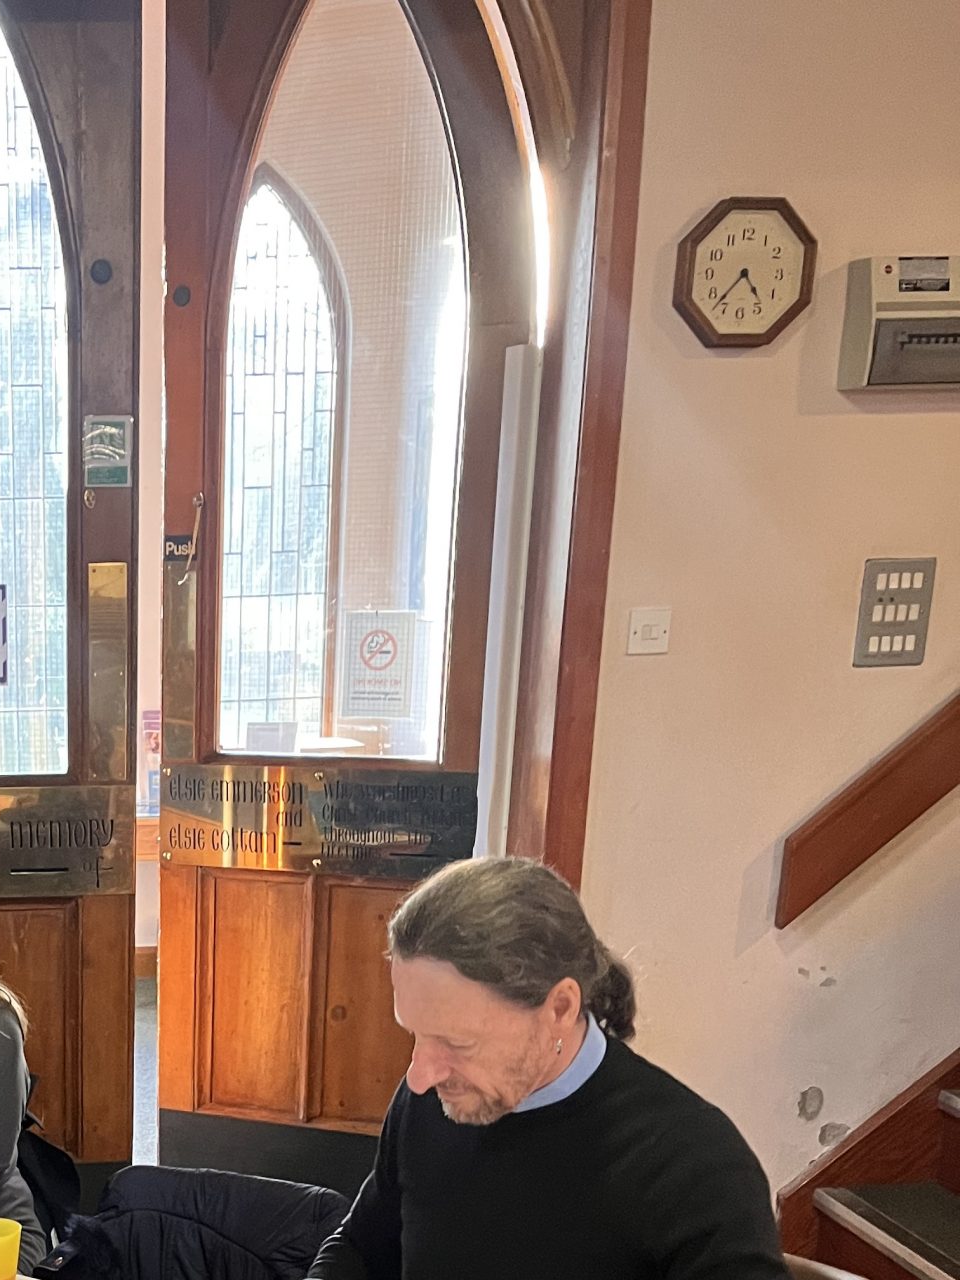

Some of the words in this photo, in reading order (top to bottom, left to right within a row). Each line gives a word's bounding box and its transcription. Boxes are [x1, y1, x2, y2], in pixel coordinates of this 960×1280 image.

[726, 234, 736, 247] 11
[742, 228, 756, 241] 12
[763, 235, 768, 246] 1
[709, 249, 724, 261] 10
[771, 246, 782, 259] 2
[705, 268, 715, 281] 9
[774, 269, 784, 281] 3
[708, 287, 718, 300] 8
[720, 303, 729, 315] 7
[735, 307, 744, 320] 6
[752, 303, 762, 315] 5
